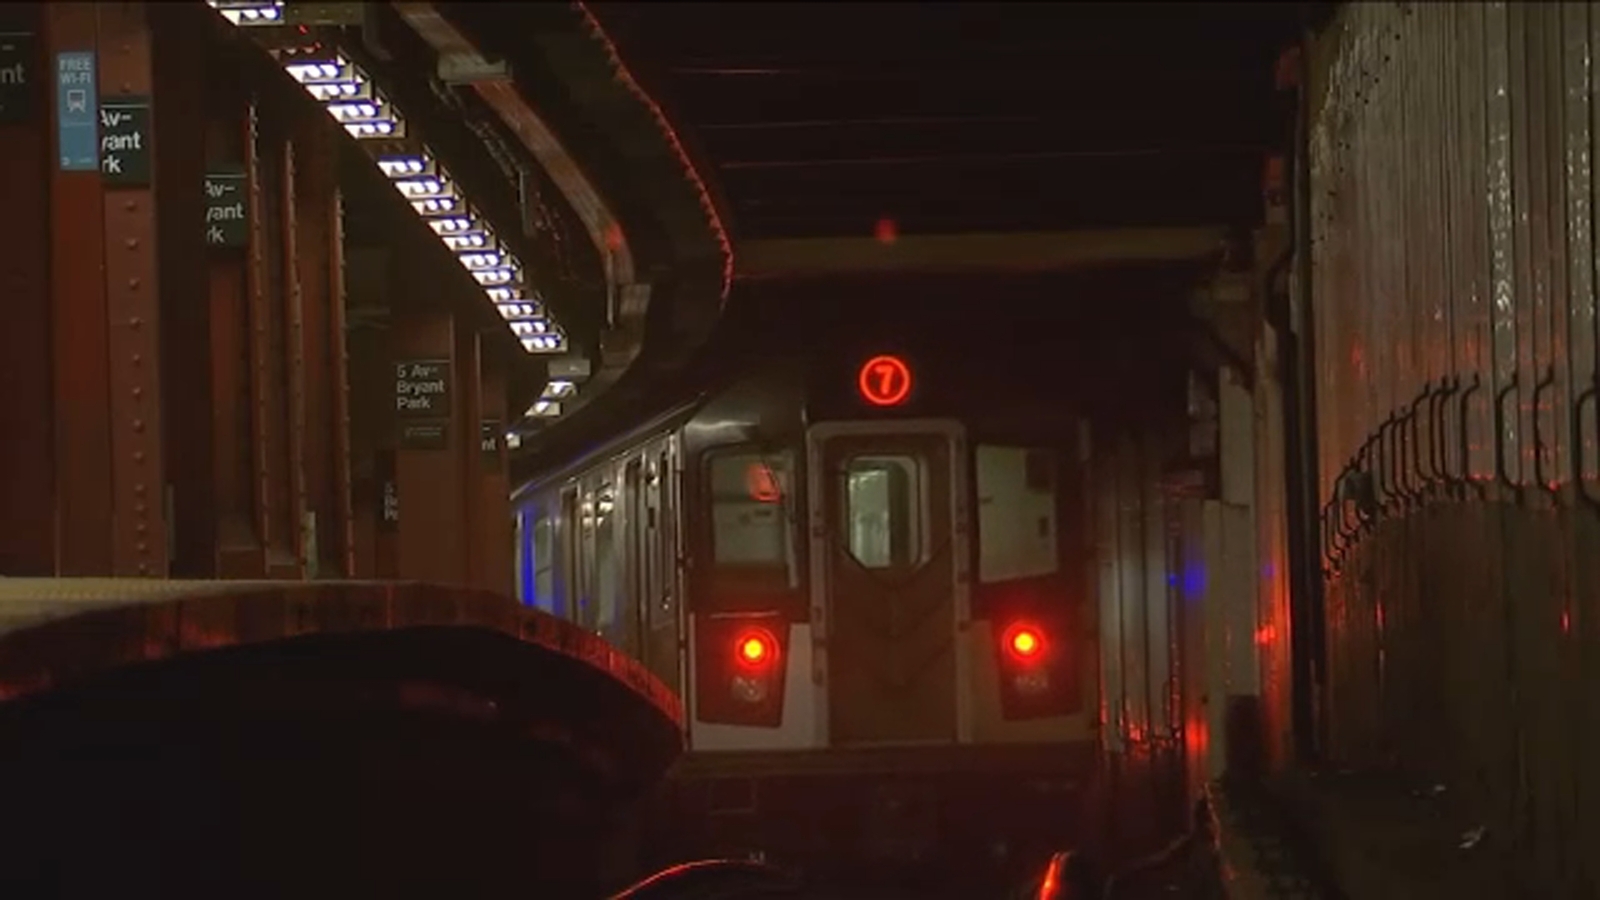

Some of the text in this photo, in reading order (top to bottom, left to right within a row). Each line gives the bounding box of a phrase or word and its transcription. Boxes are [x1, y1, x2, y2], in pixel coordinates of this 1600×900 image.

[59, 57, 92, 71] FREE
[59, 72, 92, 84] WI-FI
[397, 364, 406, 378] 5
[875, 364, 894, 394] 7
[397, 380, 445, 396] Bryant
[397, 396, 431, 410] Park
